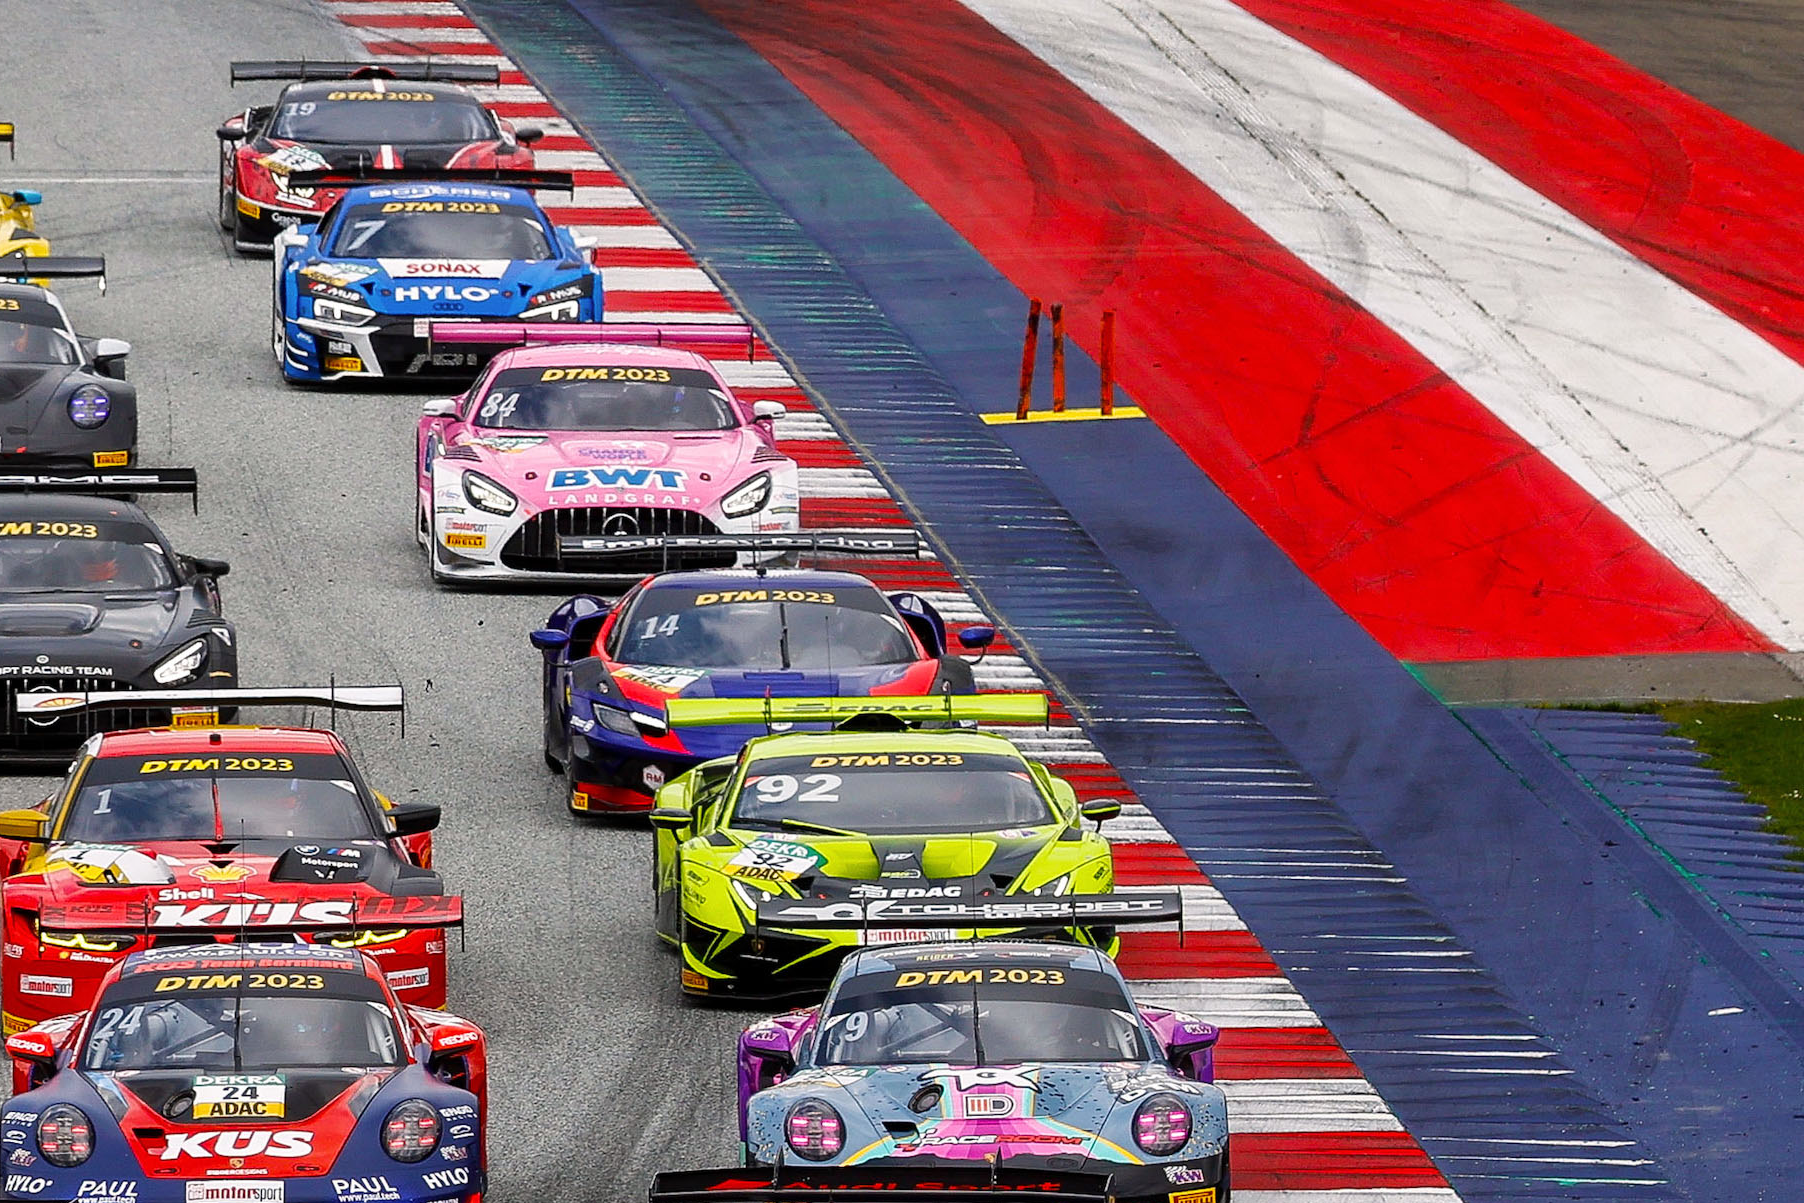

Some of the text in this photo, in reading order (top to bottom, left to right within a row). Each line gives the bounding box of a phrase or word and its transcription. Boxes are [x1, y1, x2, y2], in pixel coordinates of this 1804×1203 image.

[328, 91, 383, 101] DTM
[289, 101, 316, 117] 19
[381, 202, 500, 213] DTM 2023
[347, 220, 387, 251] 7
[406, 263, 482, 274] SONAX
[540, 367, 672, 383] DTM 2023
[479, 392, 521, 419] 84
[551, 468, 684, 489] BWT
[549, 494, 691, 506] LANDGRAF
[36, 522, 98, 539] 2023
[447, 534, 484, 547] PIRELLI
[695, 589, 836, 606] DTM 2023
[641, 613, 680, 639] 14
[22, 665, 74, 677] RACING
[76, 665, 113, 677] TEAM
[642, 665, 706, 678] DEKRA
[836, 703, 934, 713] EDAG
[139, 758, 294, 774] DTM 2023
[810, 754, 964, 768] DTM 2023
[755, 773, 843, 804] 92
[92, 789, 112, 815] 1
[301, 857, 359, 869] Motorsport
[752, 852, 790, 868] 92
[733, 866, 784, 880] ADAC
[158, 887, 214, 901] Shell
[890, 886, 962, 899] EDAG
[152, 901, 355, 927] KÜS
[878, 929, 953, 945] motorsport
[200, 959, 256, 970] Team
[258, 958, 354, 970] Bernhard
[154, 974, 326, 992] DTM 2023
[895, 968, 1065, 988] DTM 2023
[100, 1006, 146, 1036] 24
[845, 1011, 869, 1043] 9
[7, 1038, 46, 1054] RECARO
[439, 1032, 479, 1047] RECARO
[196, 1075, 284, 1086] DEKRA
[223, 1086, 260, 1100] 24
[209, 1101, 268, 1116] ADAC
[158, 1129, 315, 1160] KÜS
[918, 1134, 1084, 1146] RACEROOM
[77, 1180, 139, 1197] PAUL
[331, 1176, 398, 1194] PAUL
[205, 1186, 283, 1202] motorsport
[338, 1191, 400, 1203] www.paul.tech
